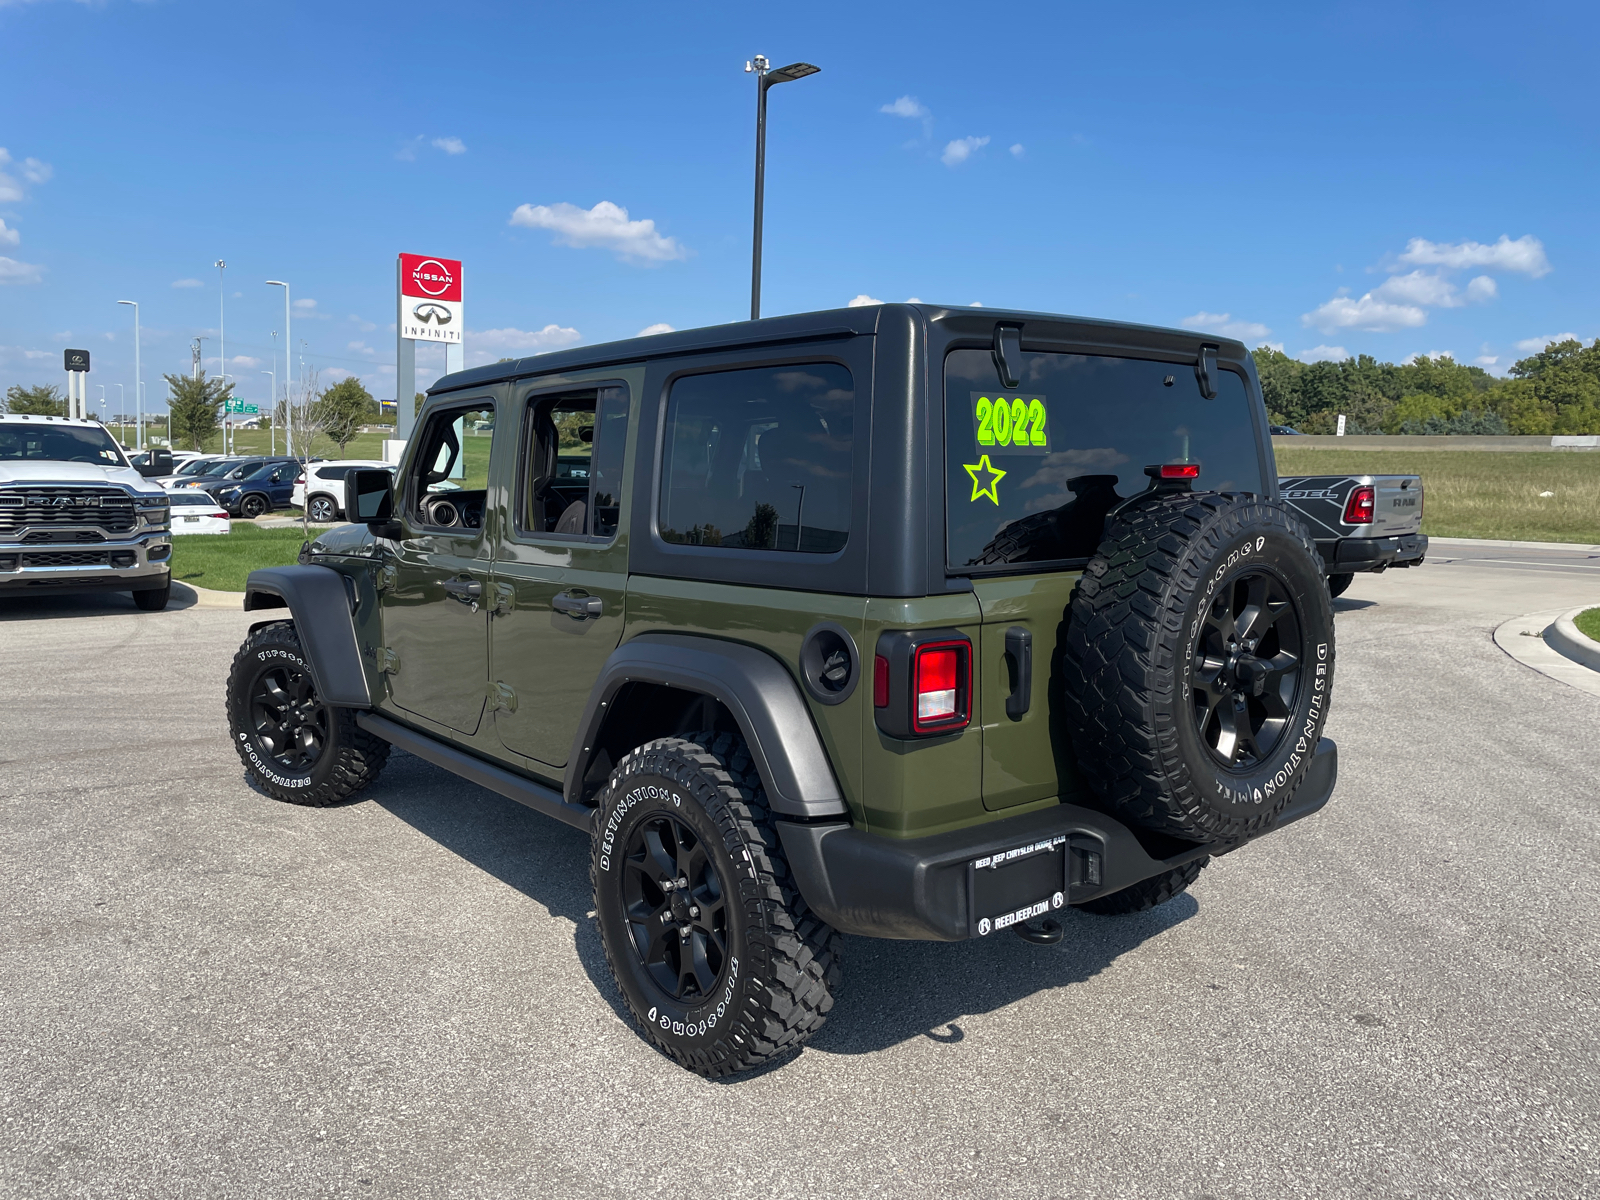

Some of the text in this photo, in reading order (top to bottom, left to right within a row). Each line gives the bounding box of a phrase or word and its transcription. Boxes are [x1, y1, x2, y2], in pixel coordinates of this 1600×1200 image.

[413, 272, 453, 283] NISSAN
[405, 326, 460, 340] INFINITI
[975, 396, 1047, 446] 2022
[27, 496, 99, 506] RAM
[1279, 489, 1339, 500] EBEL
[1393, 498, 1416, 507] RAM
[1262, 642, 1328, 799] DESTINATION
[244, 742, 312, 788] DESTINATION
[599, 784, 671, 871] DESTINATION
[975, 835, 1066, 869] REED JEEP CHRYSLER DODGE RAM
[994, 900, 1049, 930] REEDJEEP.COM
